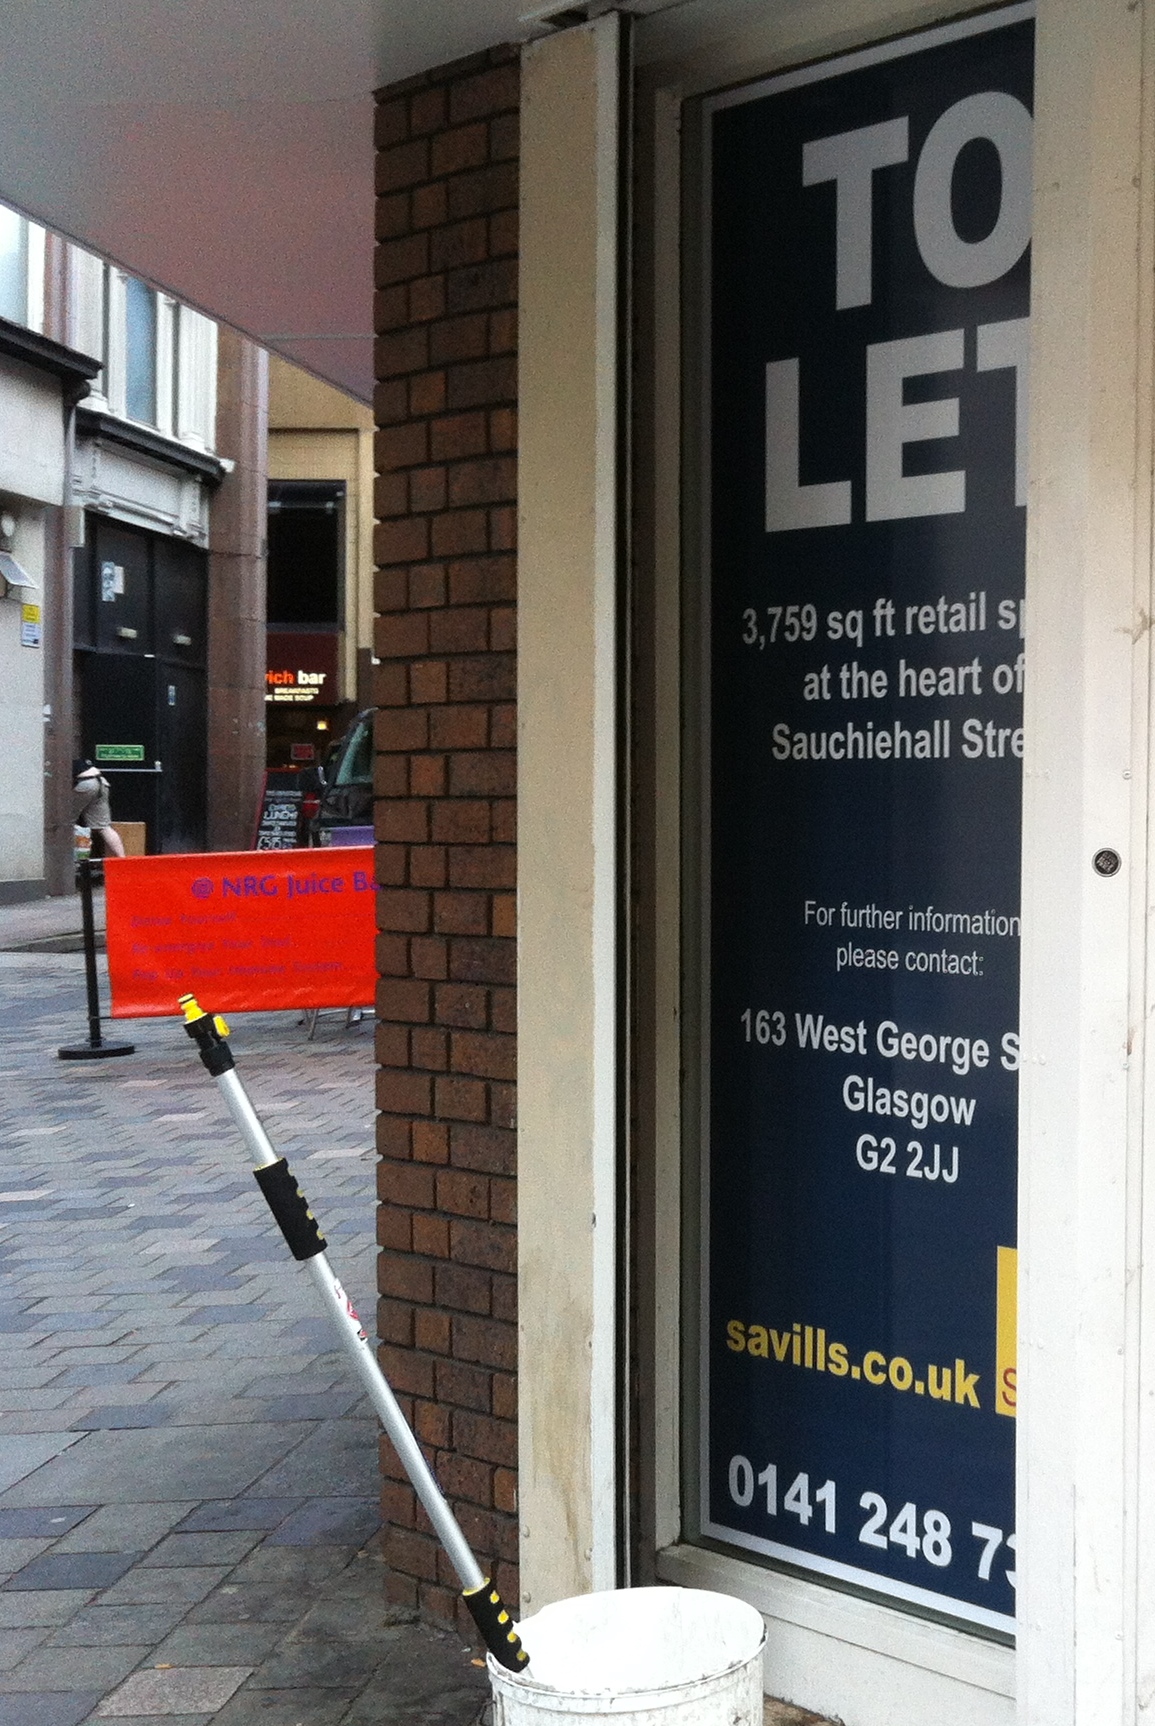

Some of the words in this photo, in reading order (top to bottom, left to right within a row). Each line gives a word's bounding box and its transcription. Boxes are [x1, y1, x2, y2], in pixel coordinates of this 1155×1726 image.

[802, 91, 1034, 311] TO
[741, 603, 818, 650] 3,759
[826, 608, 863, 648] sq
[873, 598, 896, 637] ft
[905, 591, 987, 635] retail
[298, 670, 327, 685] bar
[803, 664, 832, 701] at
[839, 661, 888, 700] the
[899, 657, 982, 698] heart
[992, 653, 1026, 694] of
[771, 719, 950, 761] Sauchiehall
[961, 717, 1025, 759] Stre
[222, 875, 278, 898] NRG
[286, 872, 345, 900] Juice
[804, 900, 836, 926] For
[840, 902, 903, 931] further
[908, 905, 1021, 937] information
[836, 942, 899, 972] please
[740, 1008, 787, 1047] 163
[794, 1012, 868, 1056] West
[876, 1020, 990, 1076] George
[842, 1074, 977, 1130] Glasgow
[855, 1133, 897, 1175] G2
[905, 1140, 960, 1184] 2JJ
[725, 1318, 981, 1409] savills.co.uk
[728, 1454, 837, 1534] 0141
[858, 1491, 952, 1567] 248
